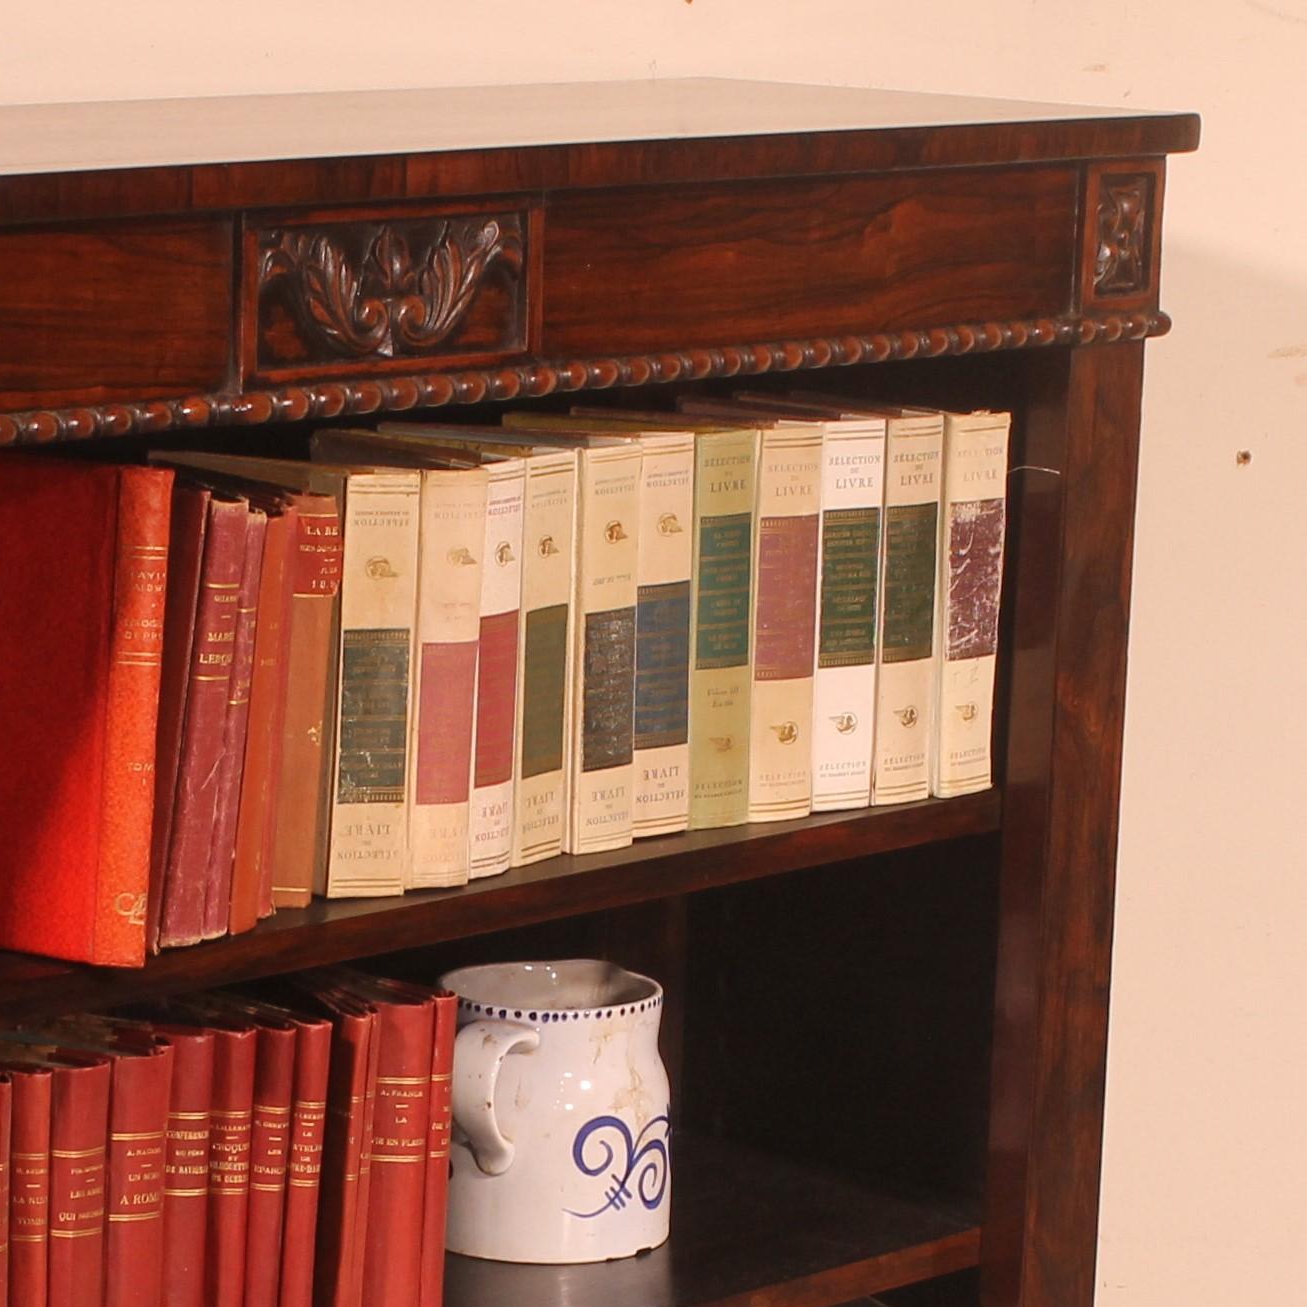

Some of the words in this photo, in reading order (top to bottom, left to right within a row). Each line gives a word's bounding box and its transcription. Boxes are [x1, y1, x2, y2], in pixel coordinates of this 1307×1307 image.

[828, 454, 882, 466] SÉLECTION
[900, 473, 935, 487] LIVRE
[963, 469, 998, 483] LIVRE
[710, 479, 747, 493] LIVRE
[835, 477, 875, 490] LIVRE
[775, 485, 814, 497] LIVRE
[642, 765, 679, 782] LIVRE
[591, 786, 625, 801] LIVRE
[345, 824, 391, 837] LIVRE
[395, 1116, 408, 1124] LA
